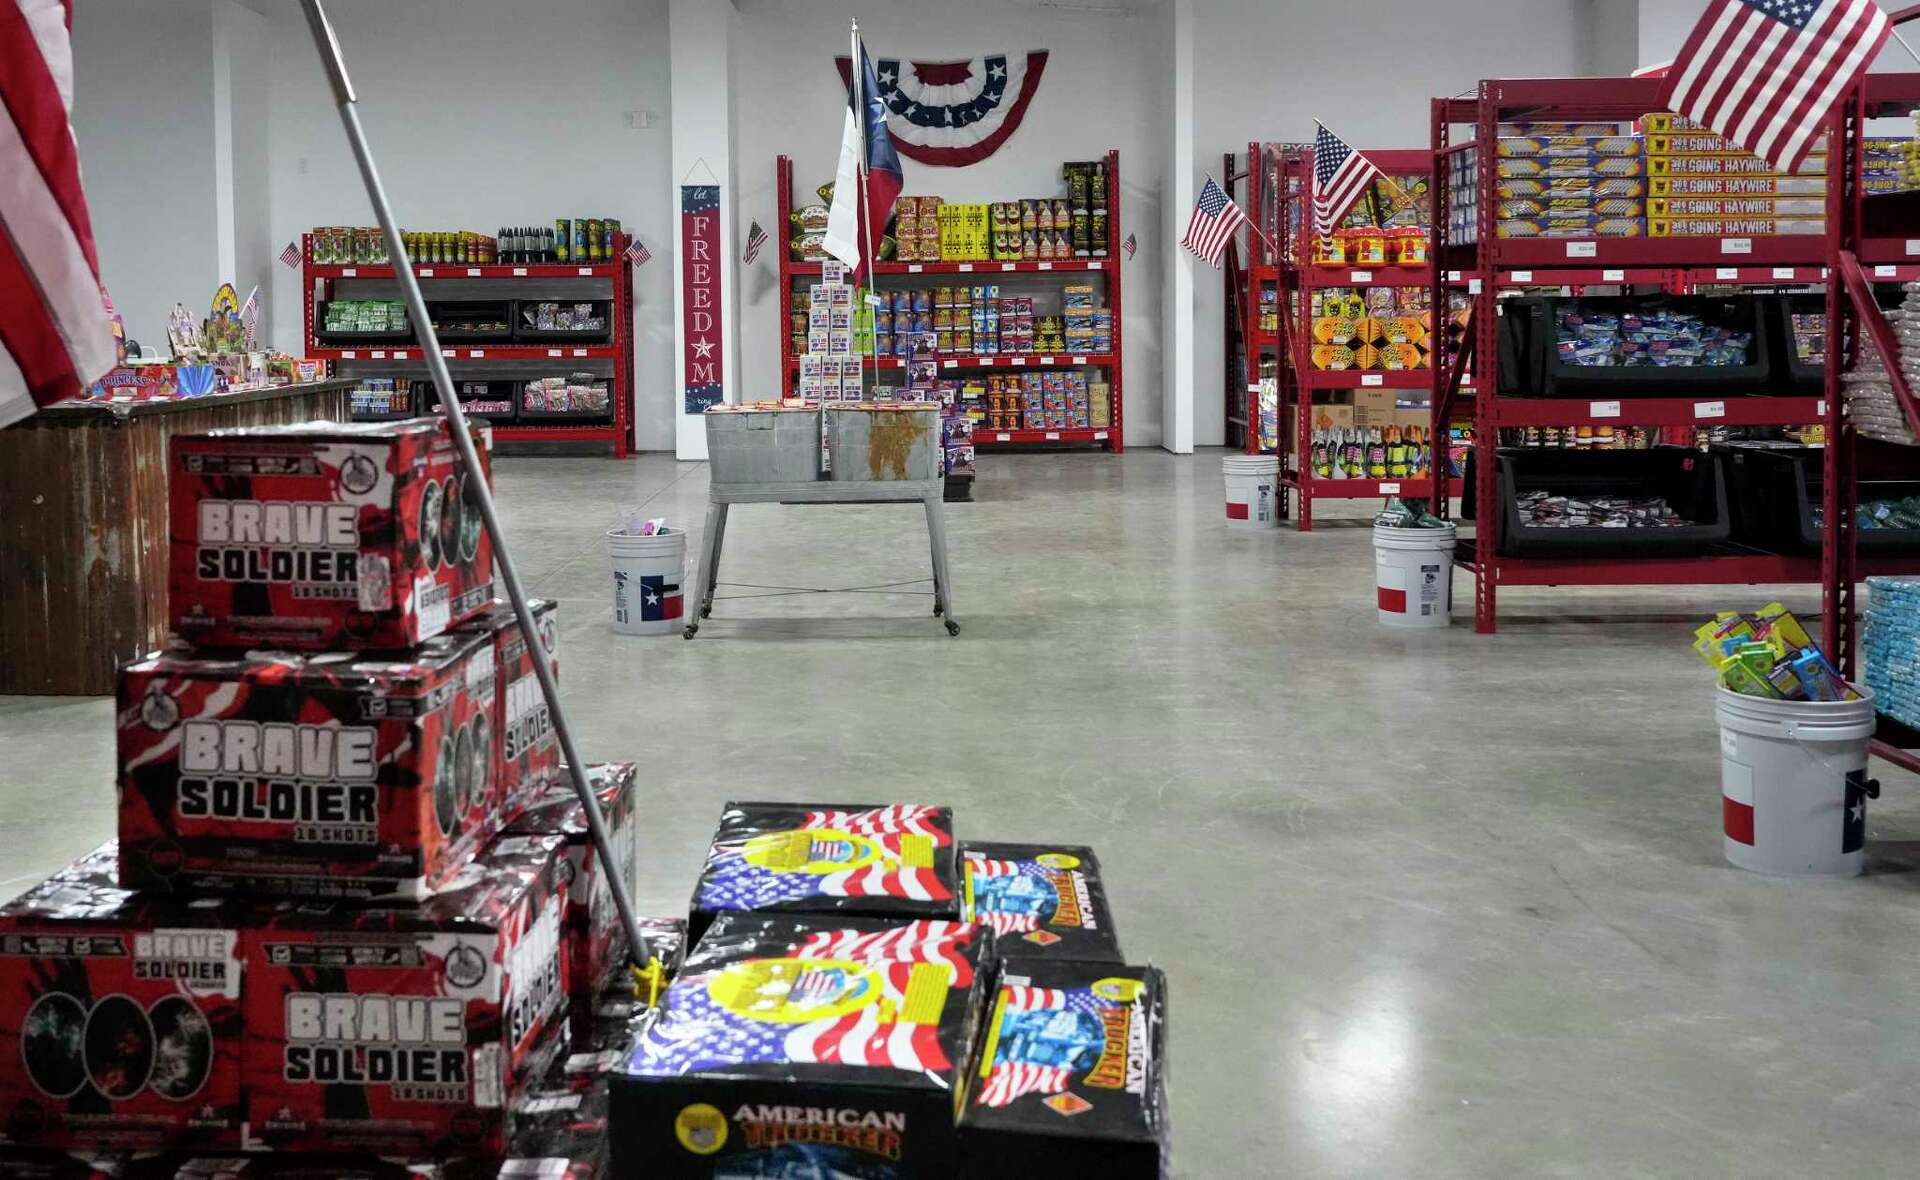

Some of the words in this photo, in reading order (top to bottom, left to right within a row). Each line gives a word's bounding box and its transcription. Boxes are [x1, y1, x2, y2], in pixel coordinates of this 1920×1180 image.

[1689, 138, 1721, 151] GOING
[1688, 159, 1721, 172] GOING
[1725, 159, 1772, 172] HAYWIRE
[1689, 179, 1721, 193] GOING
[1725, 179, 1772, 193] HAYWIRE
[1688, 200, 1721, 213] GOING
[1725, 200, 1772, 213] HAYWIRE
[1689, 220, 1721, 233] GOING
[1725, 220, 1772, 234] HAYWIRE
[692, 216, 716, 383] FREEDM
[201, 501, 358, 545] BRAVE
[200, 549, 357, 582] SOLDIER
[183, 720, 375, 779] BRAVE
[181, 779, 376, 823] SOLDIER
[321, 827, 377, 842] SHOTS
[135, 934, 225, 957] BRAVE
[135, 961, 226, 978] SOLDIER
[289, 998, 464, 1043] BRAVE
[1084, 1007, 1129, 1088] TRUCKER
[287, 1049, 466, 1082] SOLDIER
[733, 1104, 906, 1132] AMERICAN
